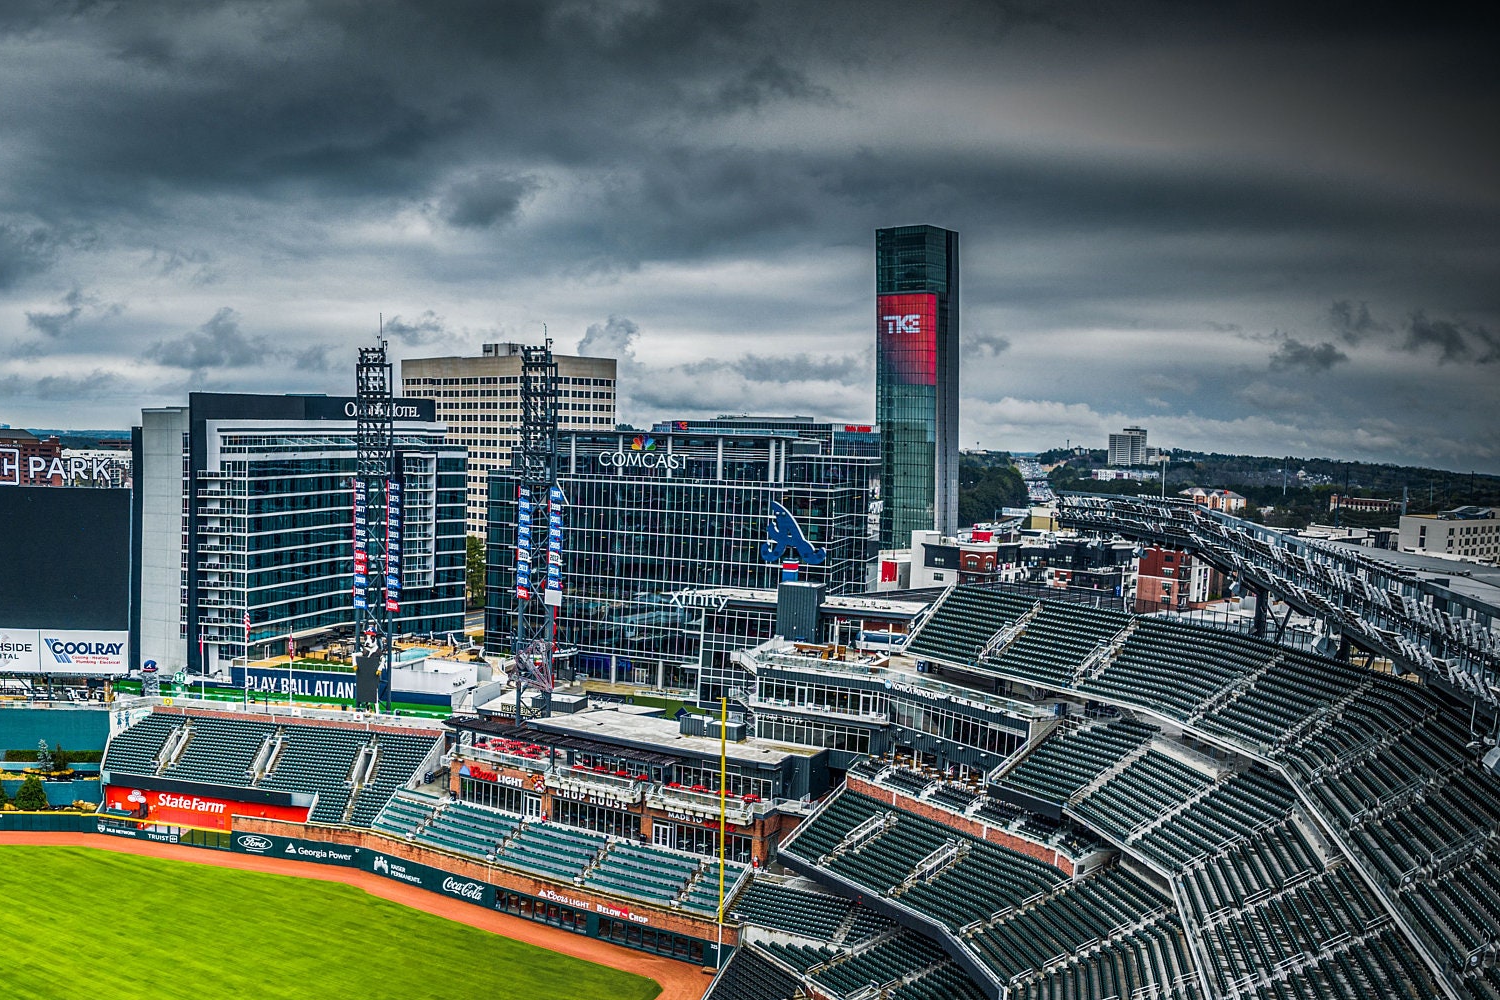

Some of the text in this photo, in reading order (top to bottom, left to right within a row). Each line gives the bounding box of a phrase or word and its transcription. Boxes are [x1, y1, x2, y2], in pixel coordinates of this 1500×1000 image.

[883, 314, 920, 334] TKE
[29, 456, 112, 480] PARK
[599, 451, 689, 469] COMCAST
[670, 587, 729, 612] xfinity
[52, 640, 123, 655] COOLRAY
[247, 675, 277, 691] PLAY
[281, 679, 311, 696] BALL
[470, 766, 523, 788] Coors LIGHT
[590, 796, 628, 811] HOUSE
[668, 812, 690, 822] MADE
[115, 829, 136, 837] NETWORK
[148, 833, 169, 842] TRUIST
[242, 836, 267, 849] Ford
[298, 848, 352, 861] Georgia Power
[547, 890, 589, 909] Coors LIGHT
[596, 904, 648, 924] BELOW CHOP
